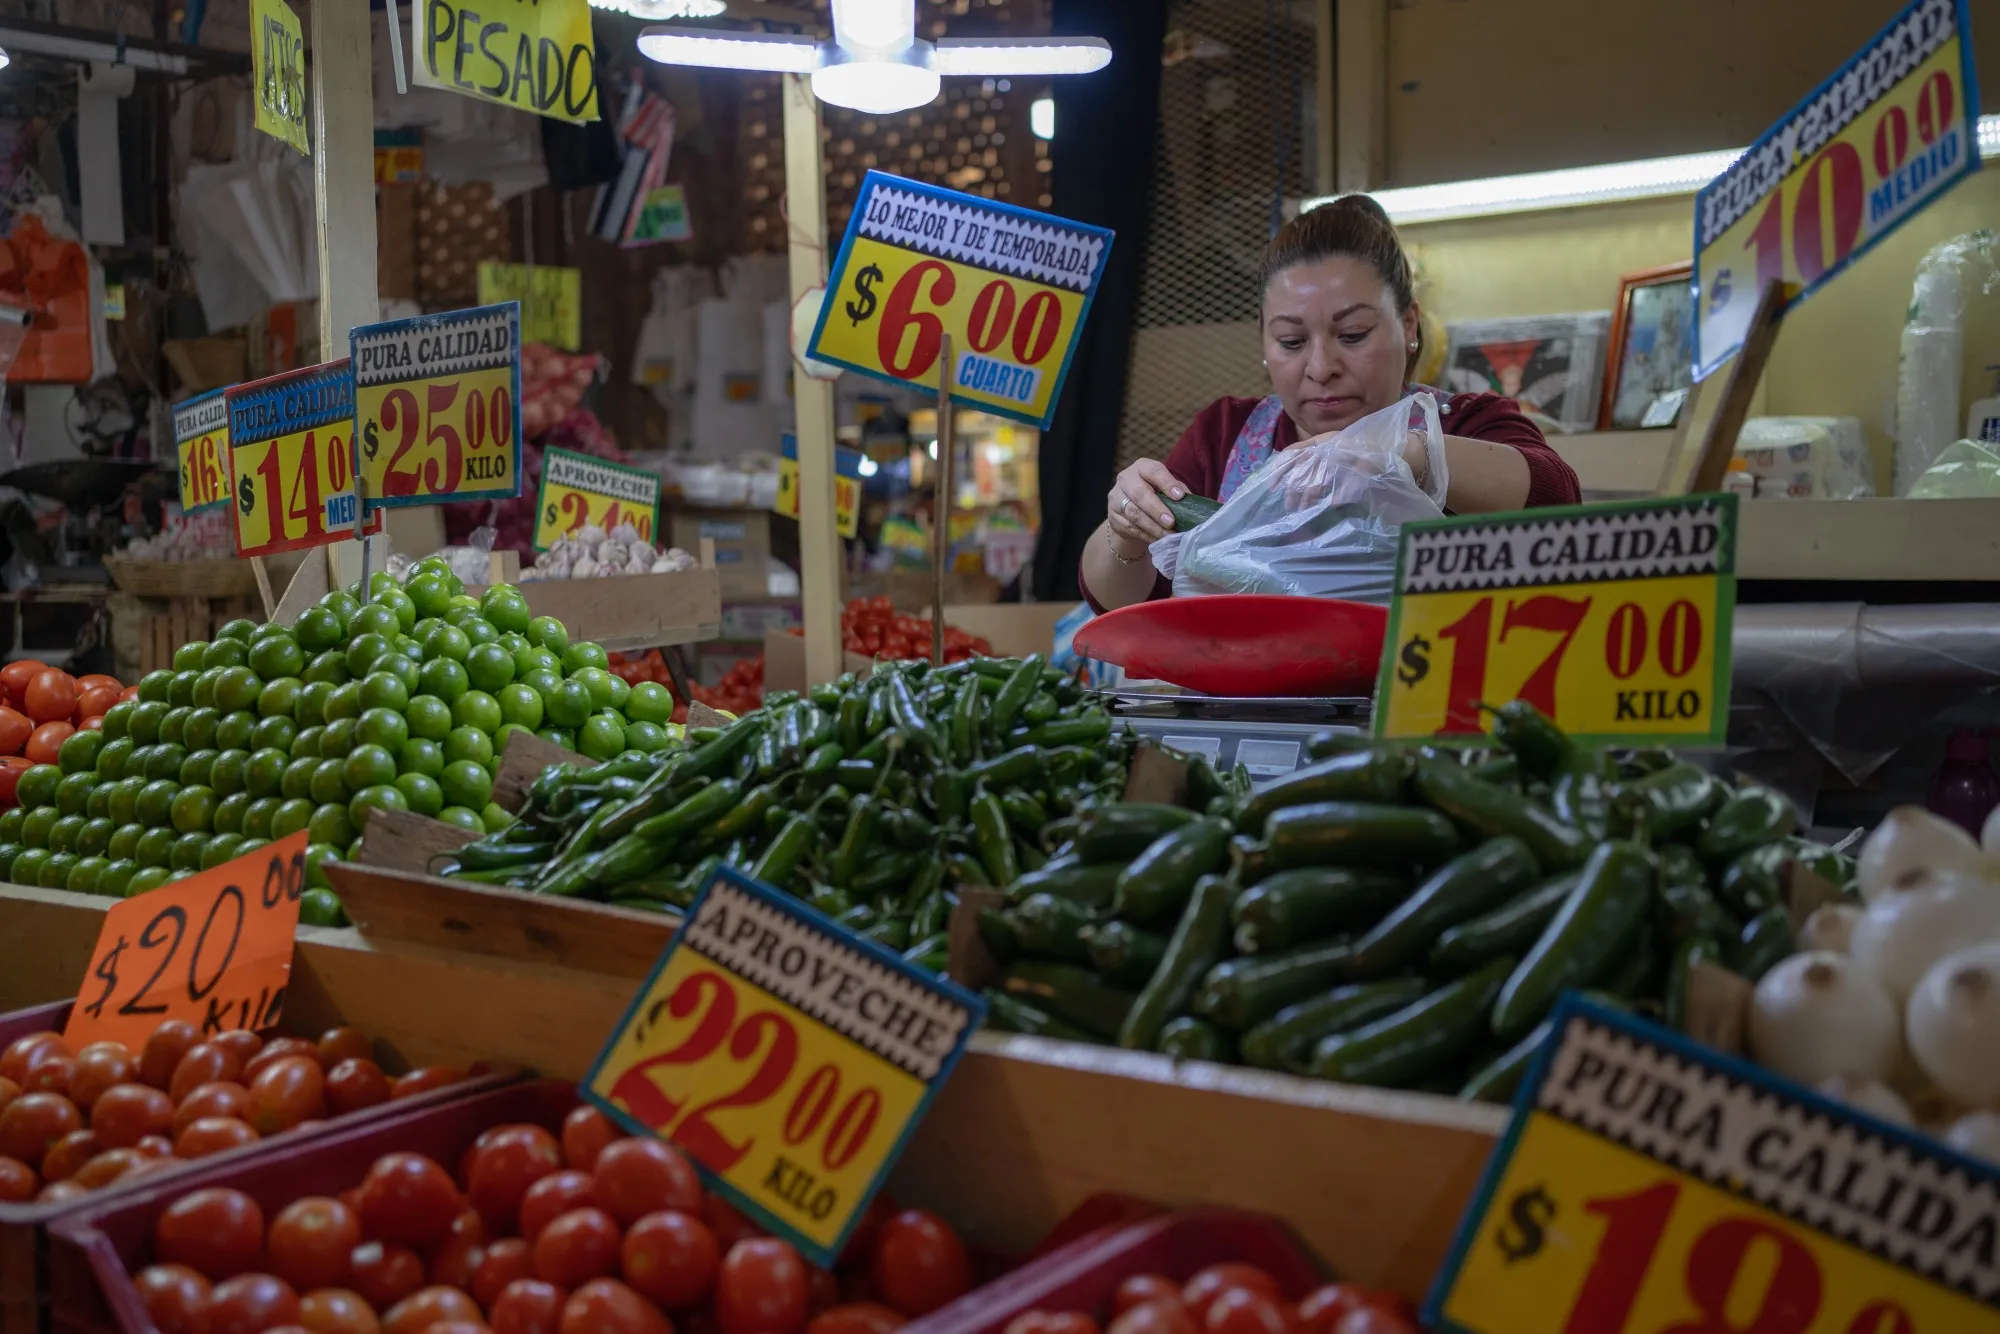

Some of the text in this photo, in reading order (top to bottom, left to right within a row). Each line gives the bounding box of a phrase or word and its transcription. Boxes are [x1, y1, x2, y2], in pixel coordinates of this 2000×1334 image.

[428, 0, 595, 117] PESADO
[1710, 2, 1948, 223] PURA CALIDAD
[1869, 132, 1958, 223] MEDIO
[866, 197, 1092, 276] LO MEJOR Y DE TEMPORADA
[361, 325, 510, 372] PURA CALIDAD
[959, 355, 1035, 400] CUARTO
[177, 415, 198, 435] PURA
[234, 380, 353, 434] PURA CALIDA
[466, 454, 506, 480] KILO
[550, 462, 653, 498] APROVECHE
[327, 494, 372, 527] MED
[1411, 523, 1719, 578] PURA CALIDAD
[1615, 689, 1700, 722] KILO
[700, 903, 953, 1058] APROVECHE
[1564, 1050, 1728, 1153] PURA
[760, 1154, 837, 1223] KILO
